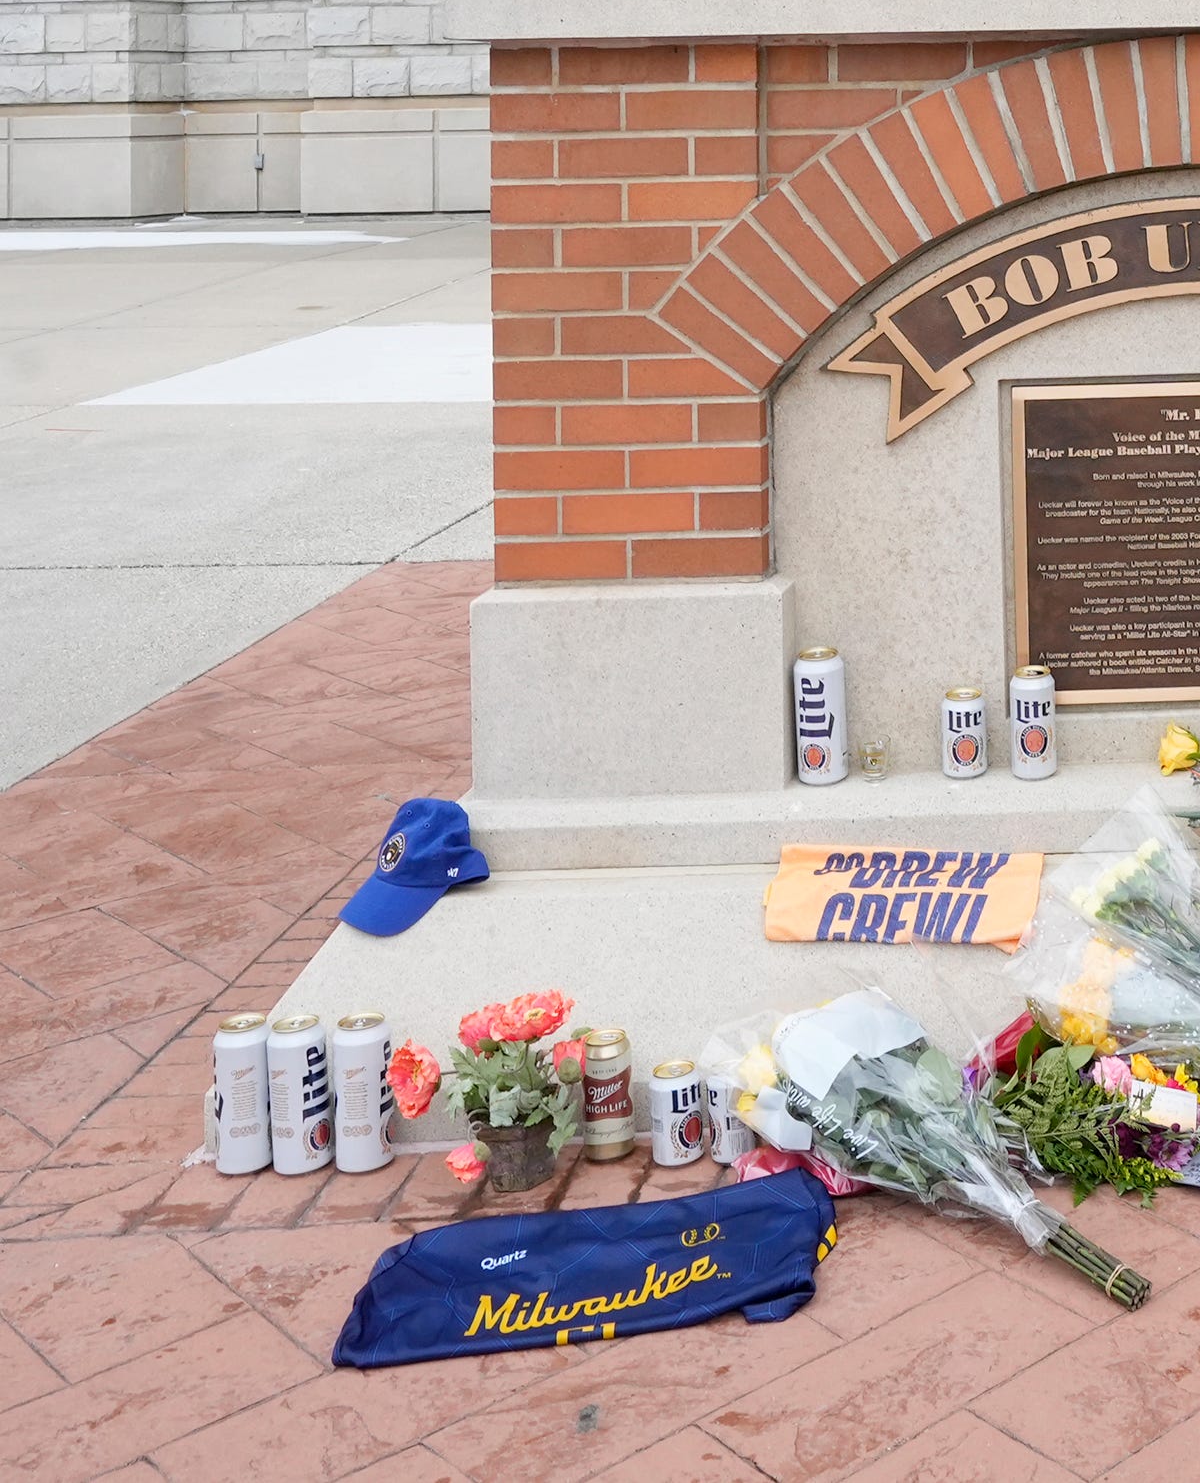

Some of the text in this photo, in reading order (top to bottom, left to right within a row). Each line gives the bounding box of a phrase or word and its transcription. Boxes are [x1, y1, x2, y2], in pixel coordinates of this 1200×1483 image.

[941, 234, 1118, 339] BOB
[1160, 409, 1189, 420] "Mr.
[1113, 432, 1146, 442] Voice
[1149, 432, 1162, 441] of
[1165, 431, 1185, 440] the
[1027, 448, 1064, 460] Major
[1068, 447, 1113, 459] League
[1116, 445, 1171, 455] Baseball
[800, 677, 835, 739] Lite
[1015, 698, 1051, 724] Lite
[948, 710, 982, 733] Lite
[588, 1079, 624, 1104] Miller
[585, 1099, 628, 1114] HIGH LIFE
[481, 1248, 527, 1271] Quartz
[464, 1255, 719, 1336] Milwaukee
